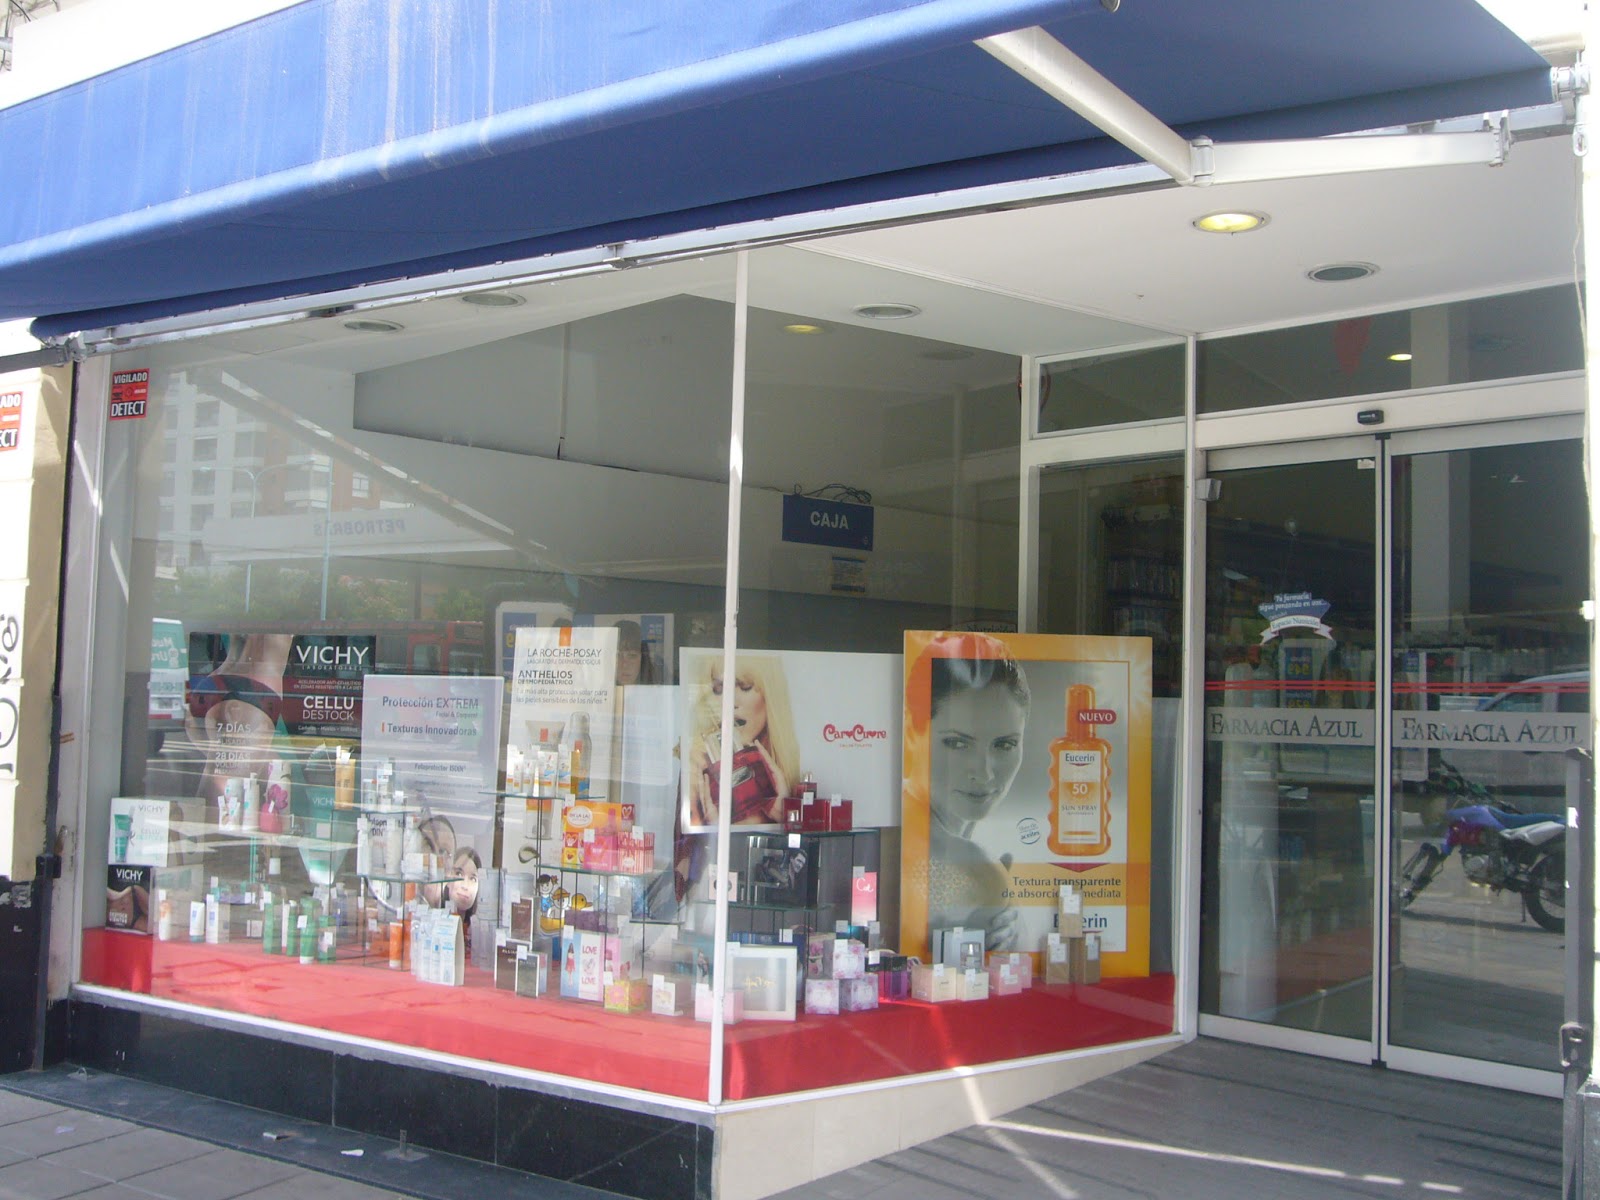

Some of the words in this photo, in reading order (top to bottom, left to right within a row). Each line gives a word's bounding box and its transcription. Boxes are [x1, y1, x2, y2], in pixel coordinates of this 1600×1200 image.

[114, 372, 148, 384] VIGILADO
[111, 400, 146, 417] DETECT
[810, 511, 849, 530] CAJA
[295, 645, 369, 665] VICHY
[527, 649, 539, 658] LA
[540, 648, 602, 658] ROCHE-POSAY
[518, 670, 573, 679] ANTHELIOS
[594, 690, 608, 698] para
[303, 695, 354, 710] CELLU
[382, 696, 433, 708] Protección
[436, 697, 479, 709] EXTREM
[302, 709, 354, 721] DESTOCK
[1079, 711, 1113, 722] NUEVO
[217, 723, 223, 733] 7
[226, 721, 251, 733] DÍAS
[387, 723, 423, 734] Texturas
[425, 725, 477, 736] Innovadoras
[215, 752, 226, 761] 28
[1065, 753, 1095, 762] Eucerin
[1072, 783, 1088, 795] 50
[138, 804, 165, 813] VICHY
[116, 869, 144, 881] VICHY
[1013, 877, 1051, 886] Textura
[1053, 877, 1121, 889] transparente
[1001, 889, 1015, 898] de
[582, 945, 598, 955] LOVE
[581, 977, 596, 985] LOVE
